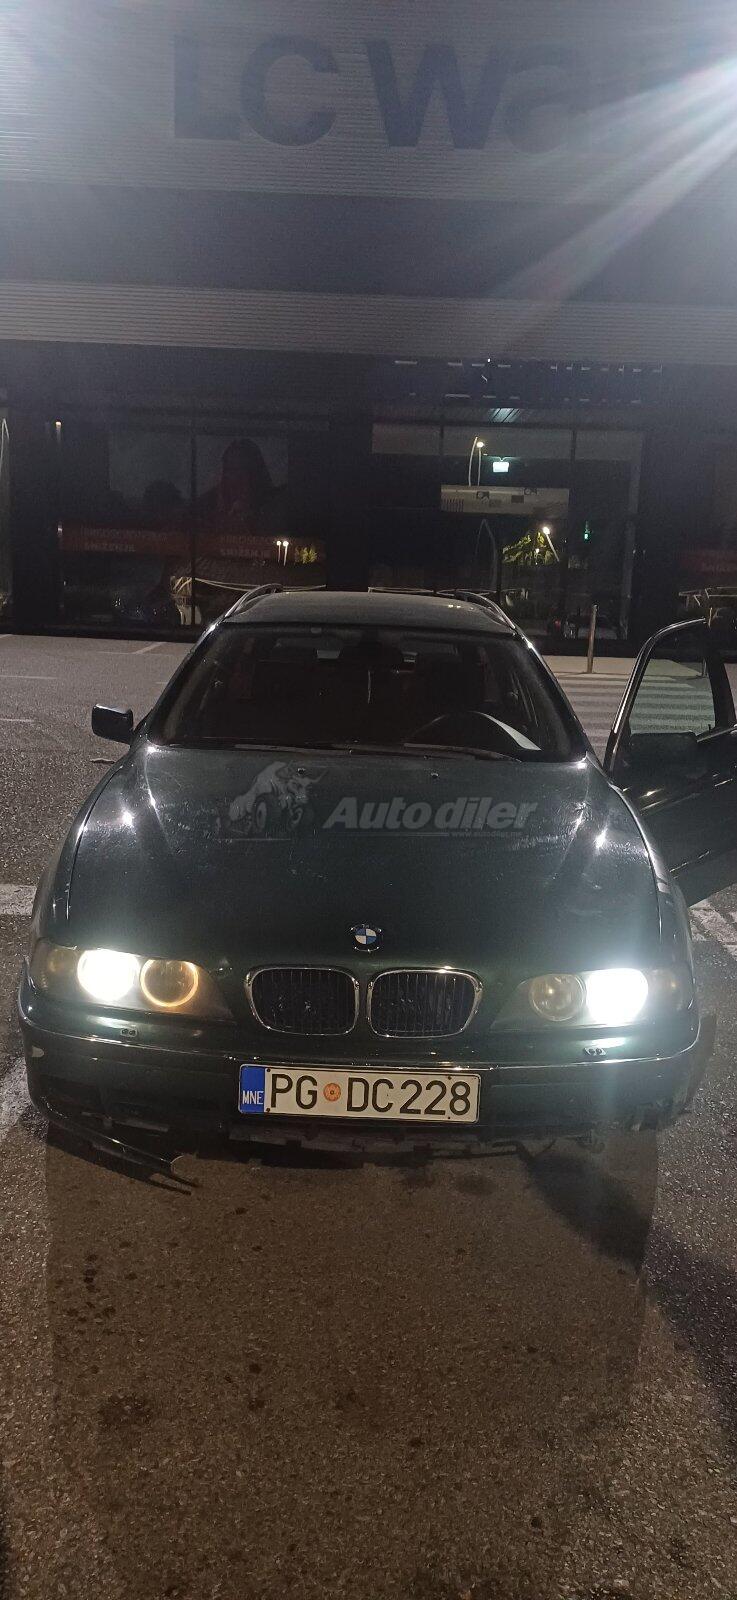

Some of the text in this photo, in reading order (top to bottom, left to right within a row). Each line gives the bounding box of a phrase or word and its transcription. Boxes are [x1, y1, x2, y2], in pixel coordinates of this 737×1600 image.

[173, 34, 340, 146] LC
[242, 1090, 264, 1105] MNE
[270, 1073, 318, 1110] PG
